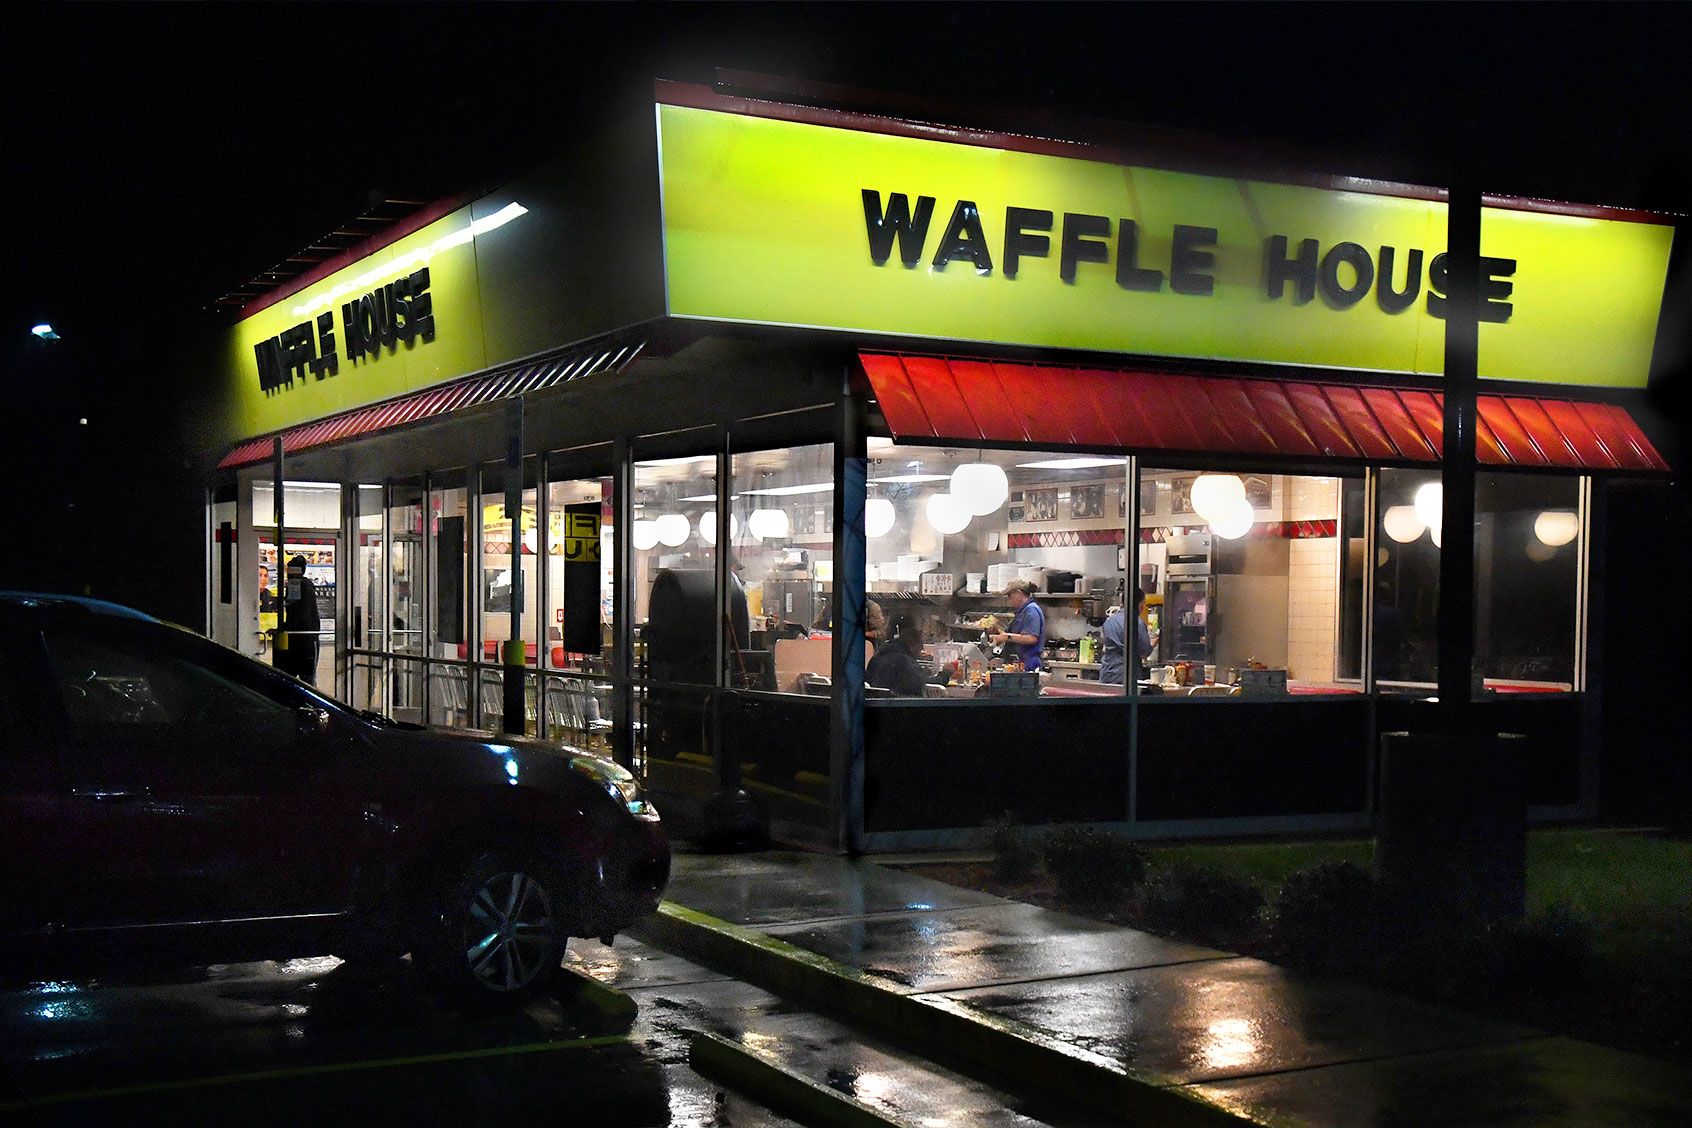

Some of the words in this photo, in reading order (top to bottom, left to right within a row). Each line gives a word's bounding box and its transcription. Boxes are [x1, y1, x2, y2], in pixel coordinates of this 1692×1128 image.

[861, 189, 1218, 295] WAFFLE
[1267, 235, 1517, 324] HOUSE
[254, 311, 339, 396] WAFFLE
[341, 267, 435, 364] HOUSE
